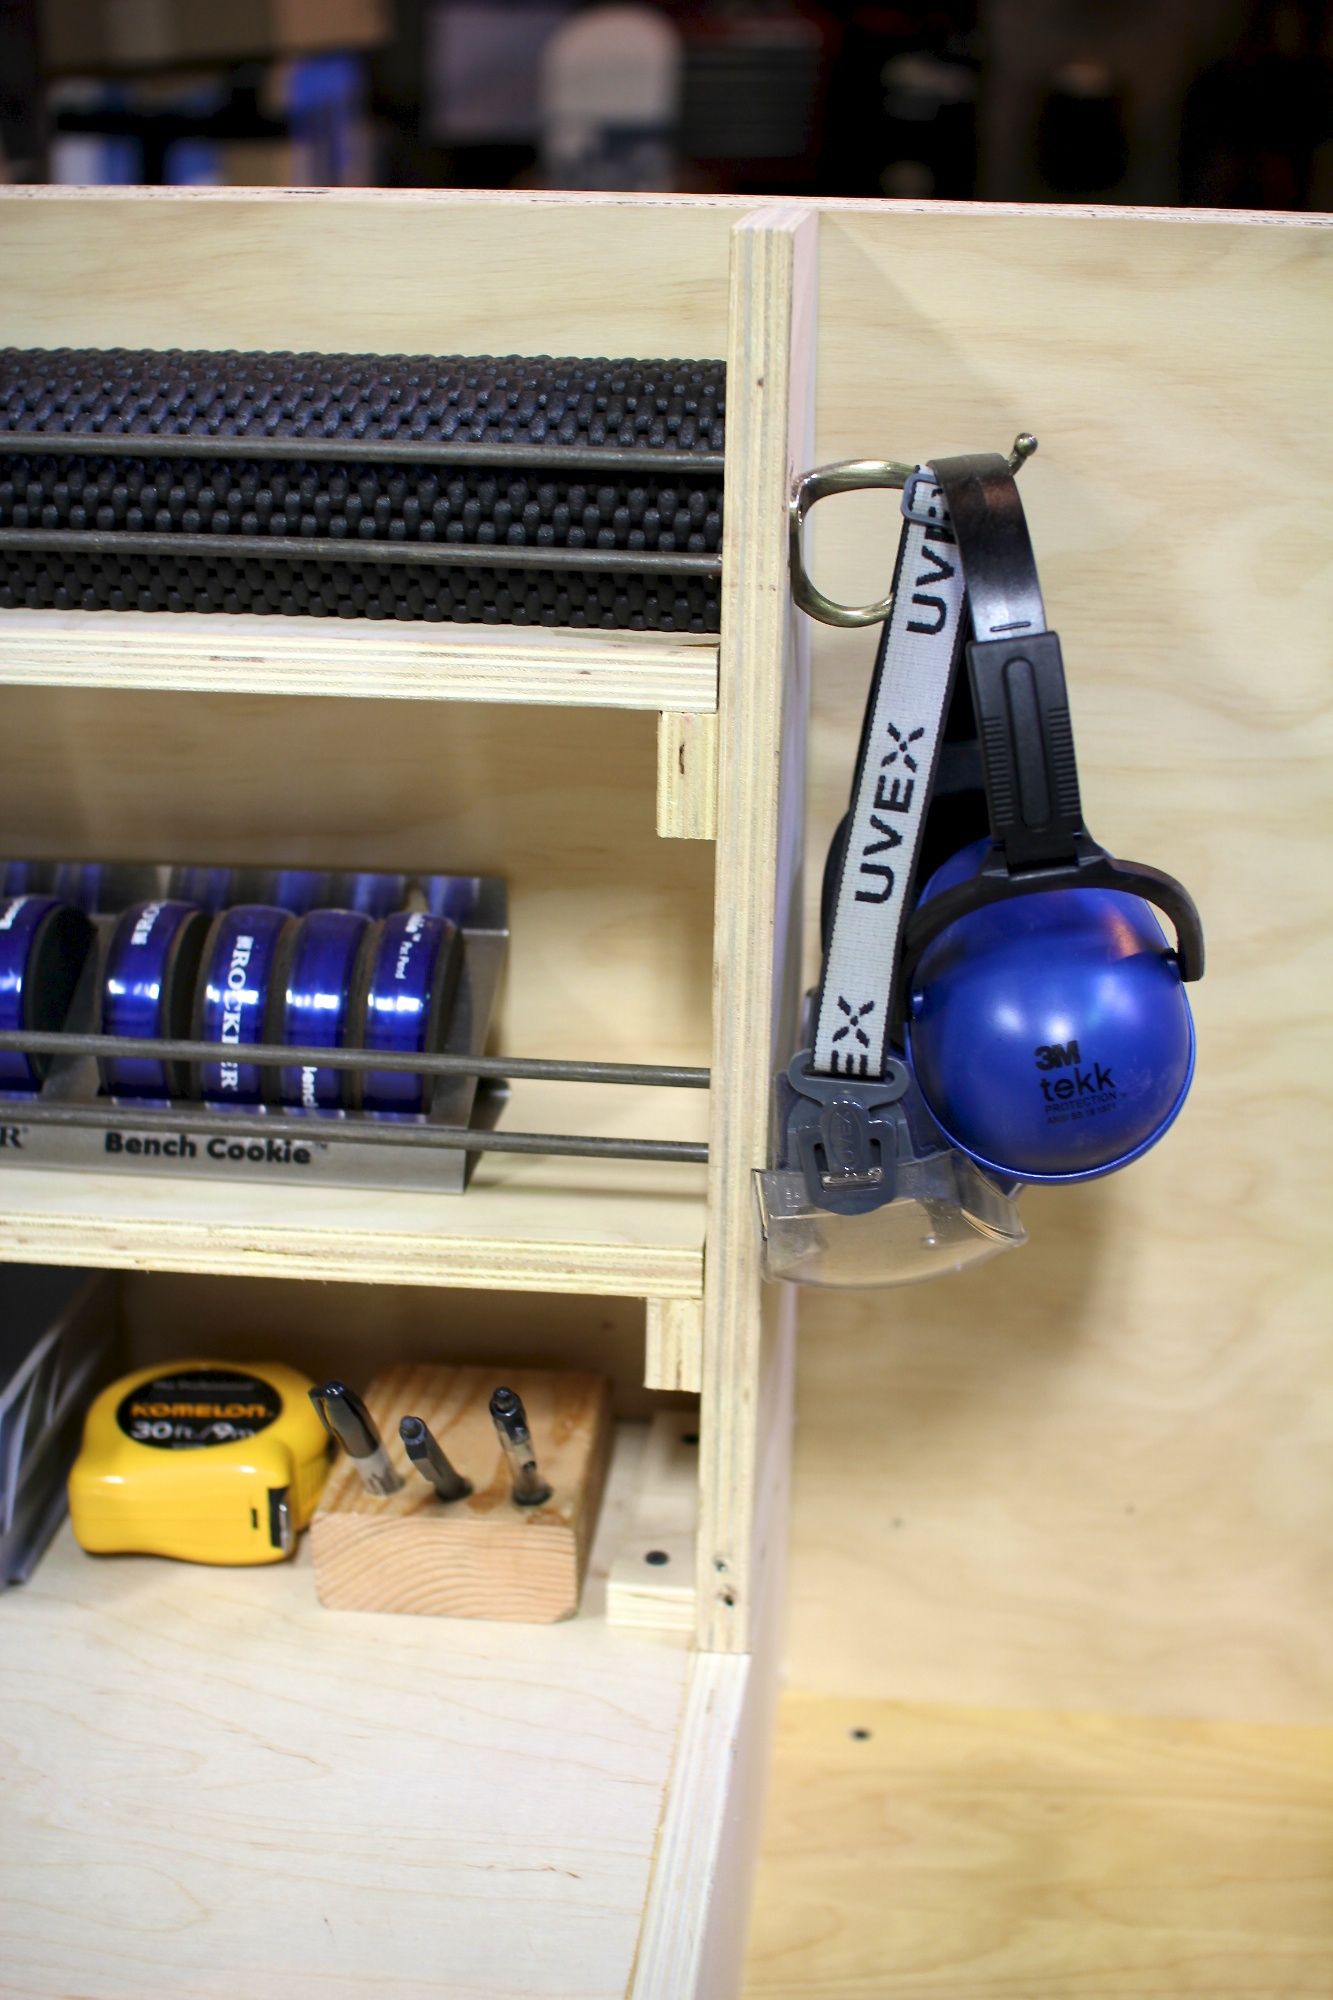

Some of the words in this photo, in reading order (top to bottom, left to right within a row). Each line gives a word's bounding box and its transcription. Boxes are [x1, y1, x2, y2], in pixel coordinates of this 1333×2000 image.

[854, 721, 925, 905] UVEX
[1034, 1040, 1081, 1071] 3M
[1040, 1062, 1116, 1102] tekk
[104, 1131, 197, 1158] Bench
